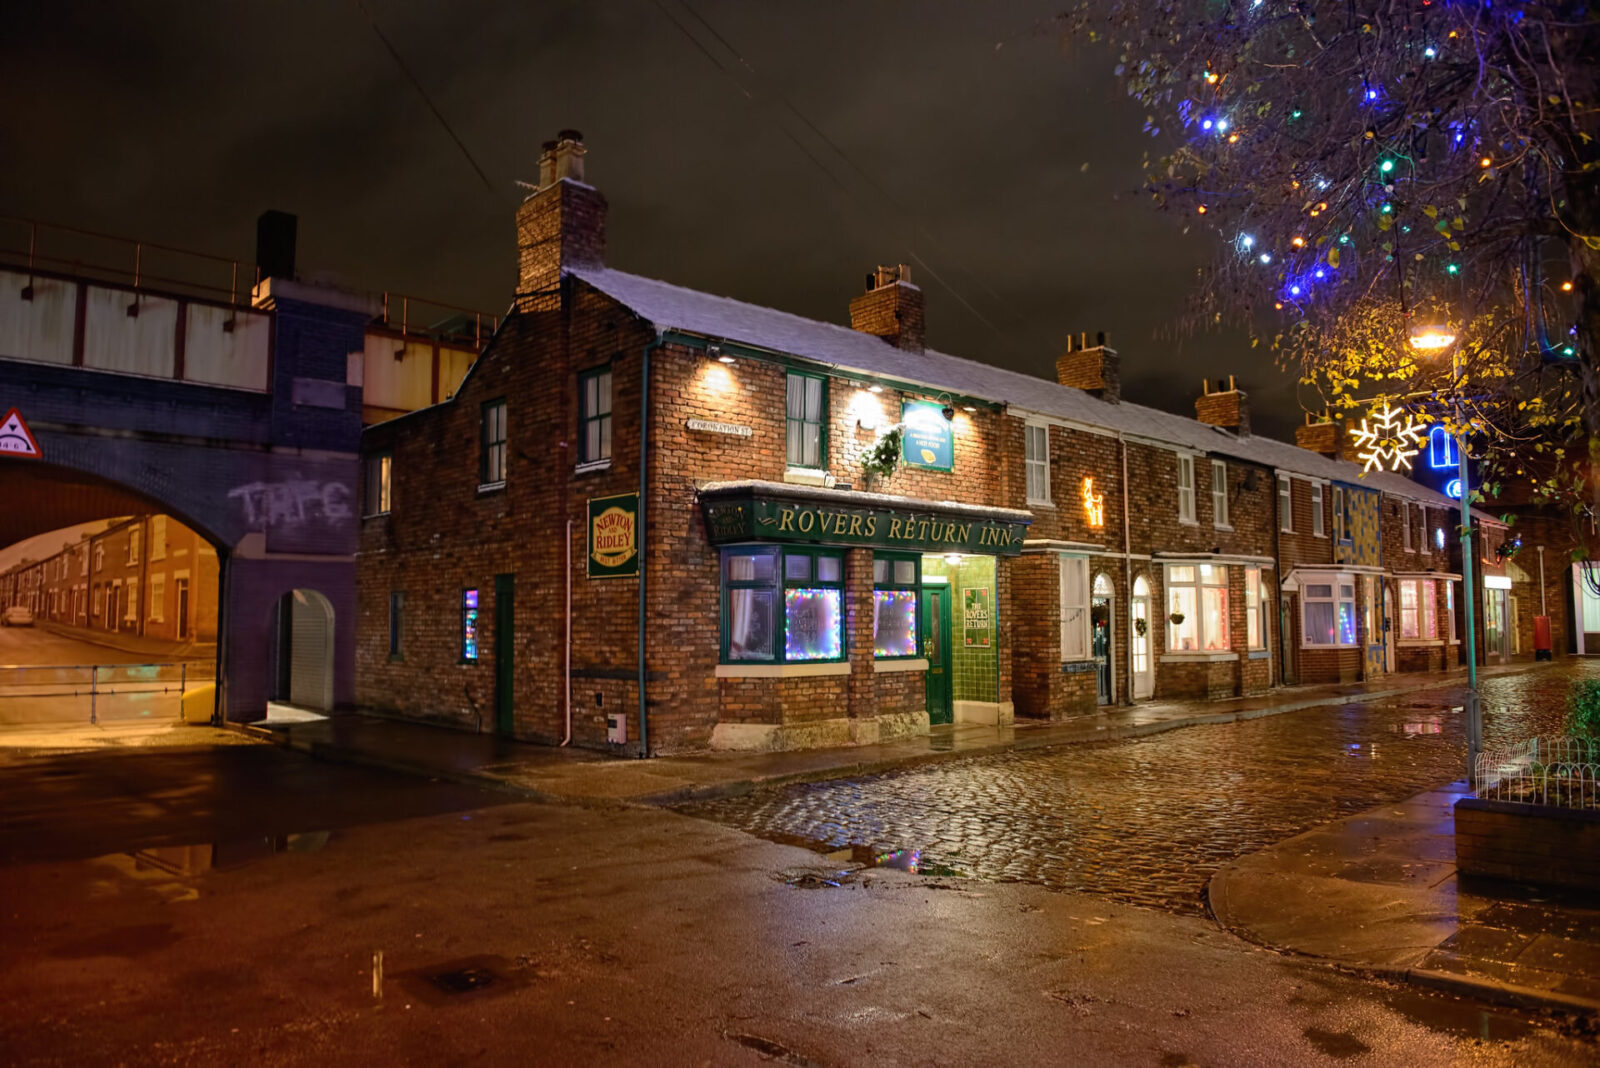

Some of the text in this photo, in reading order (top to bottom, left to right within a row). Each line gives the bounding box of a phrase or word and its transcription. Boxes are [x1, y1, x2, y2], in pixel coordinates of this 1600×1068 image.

[596, 513, 633, 536] NEWTON
[778, 509, 1013, 547] ROVERS RETURN INN
[596, 532, 631, 550] RIDLEY
[965, 609, 988, 619] ROVERS
[965, 619, 988, 628] RETURN
